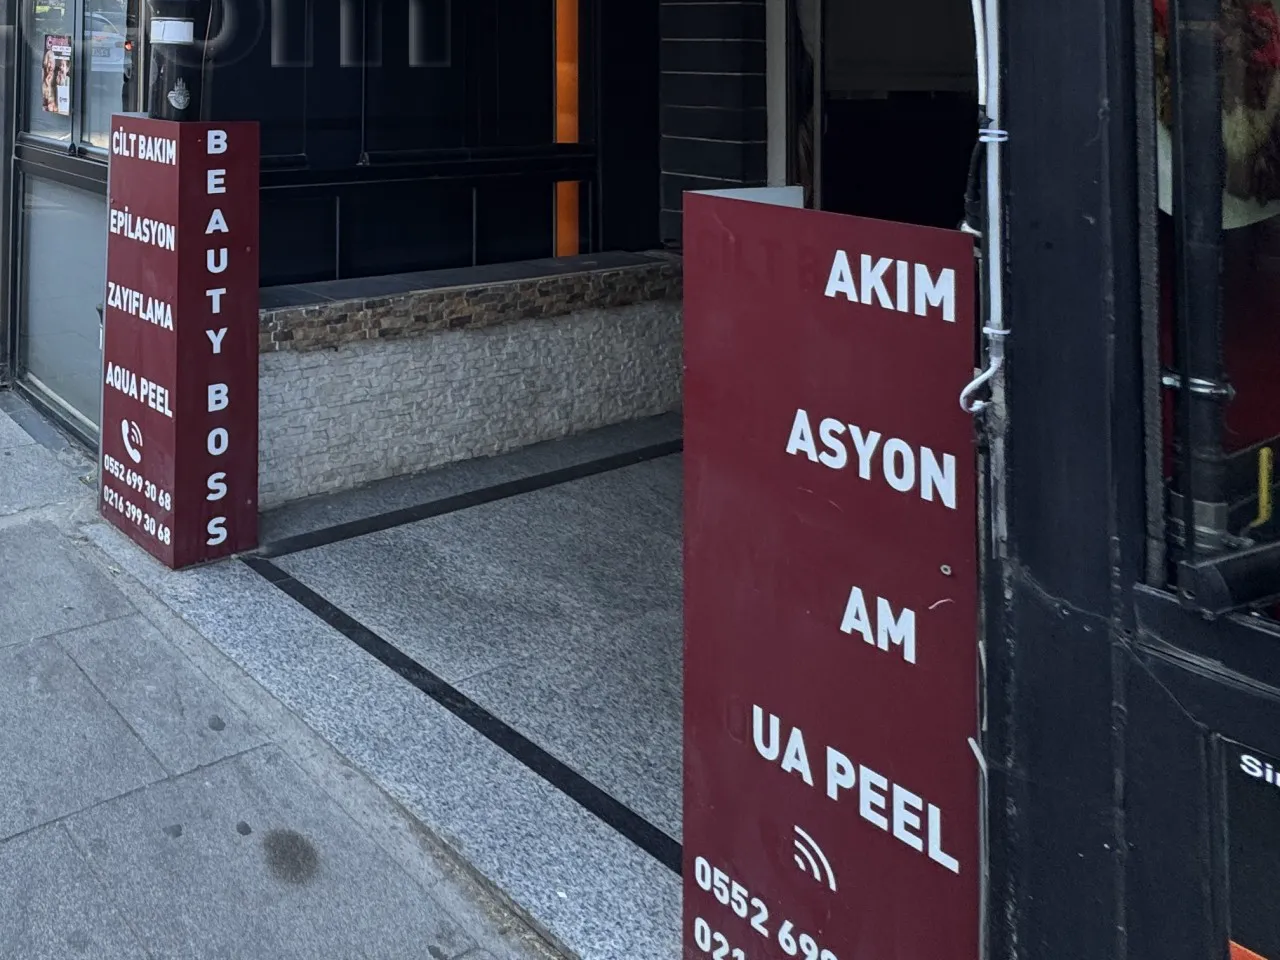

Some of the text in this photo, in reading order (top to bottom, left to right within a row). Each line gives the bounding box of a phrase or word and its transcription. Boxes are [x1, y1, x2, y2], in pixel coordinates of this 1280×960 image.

[112, 126, 177, 166] CİLT BAKIM
[110, 206, 175, 252] EPİLASYON
[107, 281, 174, 331] ZAYIFLAMA
[824, 249, 956, 323] AKIM
[205, 129, 230, 546] BEAUTY BOSS
[105, 361, 173, 418] AQUA PEEL
[104, 454, 171, 511] 0552 699 30 68
[785, 408, 956, 510] ASYON
[103, 485, 171, 546] 0216 399 30 68
[840, 585, 916, 664] AM
[753, 704, 960, 874] UA PEEL
[695, 856, 769, 938] 0552
